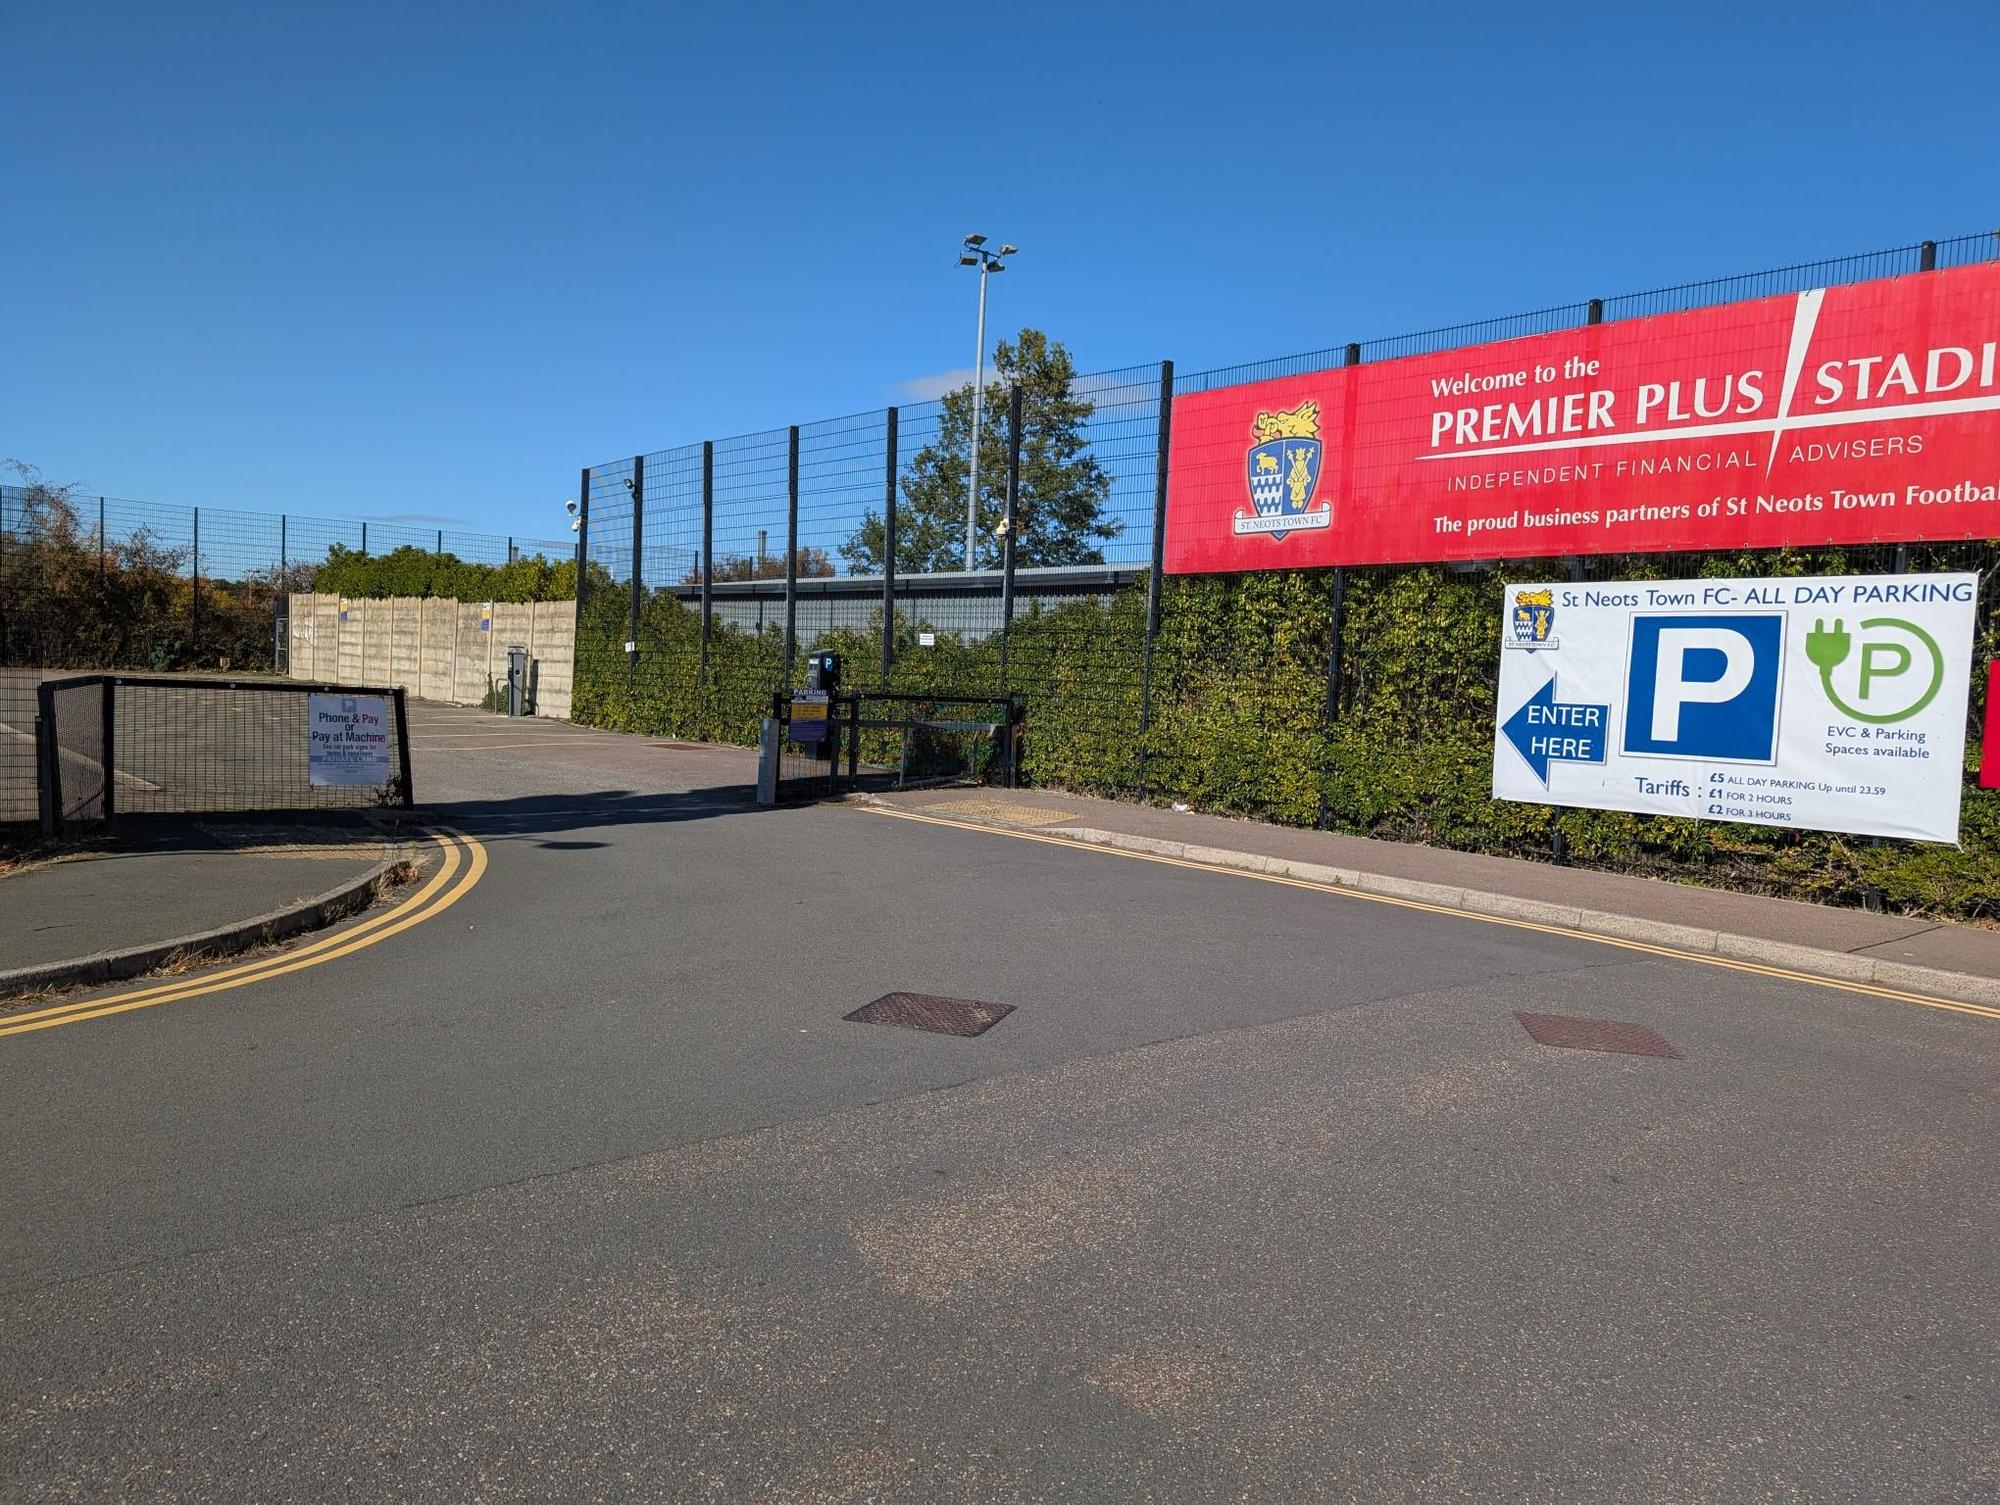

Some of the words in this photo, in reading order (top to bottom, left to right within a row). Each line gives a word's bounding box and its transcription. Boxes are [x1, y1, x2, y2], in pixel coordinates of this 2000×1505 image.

[1431, 373, 1527, 398] Welcome
[1535, 365, 1556, 384] to
[1564, 356, 1600, 379] the
[1431, 390, 1616, 447] PREMIER
[1637, 370, 1764, 424] PLUS
[1815, 341, 1997, 405] STADI
[1448, 463, 1603, 491] INDEPENDENT
[1617, 451, 1758, 477] FINANCIAL
[1789, 435, 1923, 463] ADVISERS
[1253, 519, 1281, 529] NEOTS
[1282, 516, 1310, 526] TOWN
[1311, 515, 1323, 523] FC
[1434, 516, 1462, 533] The
[1467, 511, 1518, 536] proud
[1523, 507, 1600, 528] business
[1605, 504, 1690, 528] partners
[1697, 496, 1720, 517] of
[1726, 497, 1748, 516] St
[1756, 494, 1824, 514] Neots
[1830, 490, 1896, 509] Town
[1562, 591, 1579, 608] St
[1585, 591, 1638, 607] Neots
[1646, 589, 1695, 606] Town
[1744, 587, 1786, 605] ALL
[1794, 586, 1845, 604] DAY
[1853, 582, 1973, 604] PARKING
[1858, 642, 1912, 700] P
[1651, 627, 1755, 741] P
[319, 712, 350, 723] Phone
[352, 714, 360, 723] &
[362, 714, 379, 726] Pay
[1527, 705, 1600, 727] ENTER
[312, 731, 331, 743] Pay
[333, 732, 343, 741] at
[345, 732, 386, 743] Machine
[345, 723, 355, 732] or
[1827, 725, 1857, 738] EVC
[1860, 727, 1871, 739] &
[1875, 728, 1927, 745] Parking
[1531, 736, 1592, 759] HERE
[1825, 742, 1869, 757] Spaces
[1873, 746, 1930, 759] available
[1634, 776, 1690, 797] Tariffs
[1710, 772, 1725, 783] £5
[1728, 776, 1745, 785] ALL
[1747, 777, 1768, 787] DAY
[1770, 779, 1816, 791] PARKING
[1818, 782, 1833, 793] Up
[1835, 785, 1857, 793] until
[1859, 786, 1886, 796] 23.59
[1709, 788, 1723, 799] £1
[1726, 791, 1746, 801] FOR
[1748, 793, 1754, 801] 2
[1756, 794, 1793, 805] HOURS
[1708, 804, 1723, 815] £2
[1725, 808, 1745, 817] FOR
[1747, 809, 1753, 818] 3
[1755, 810, 1792, 821] HOURS
